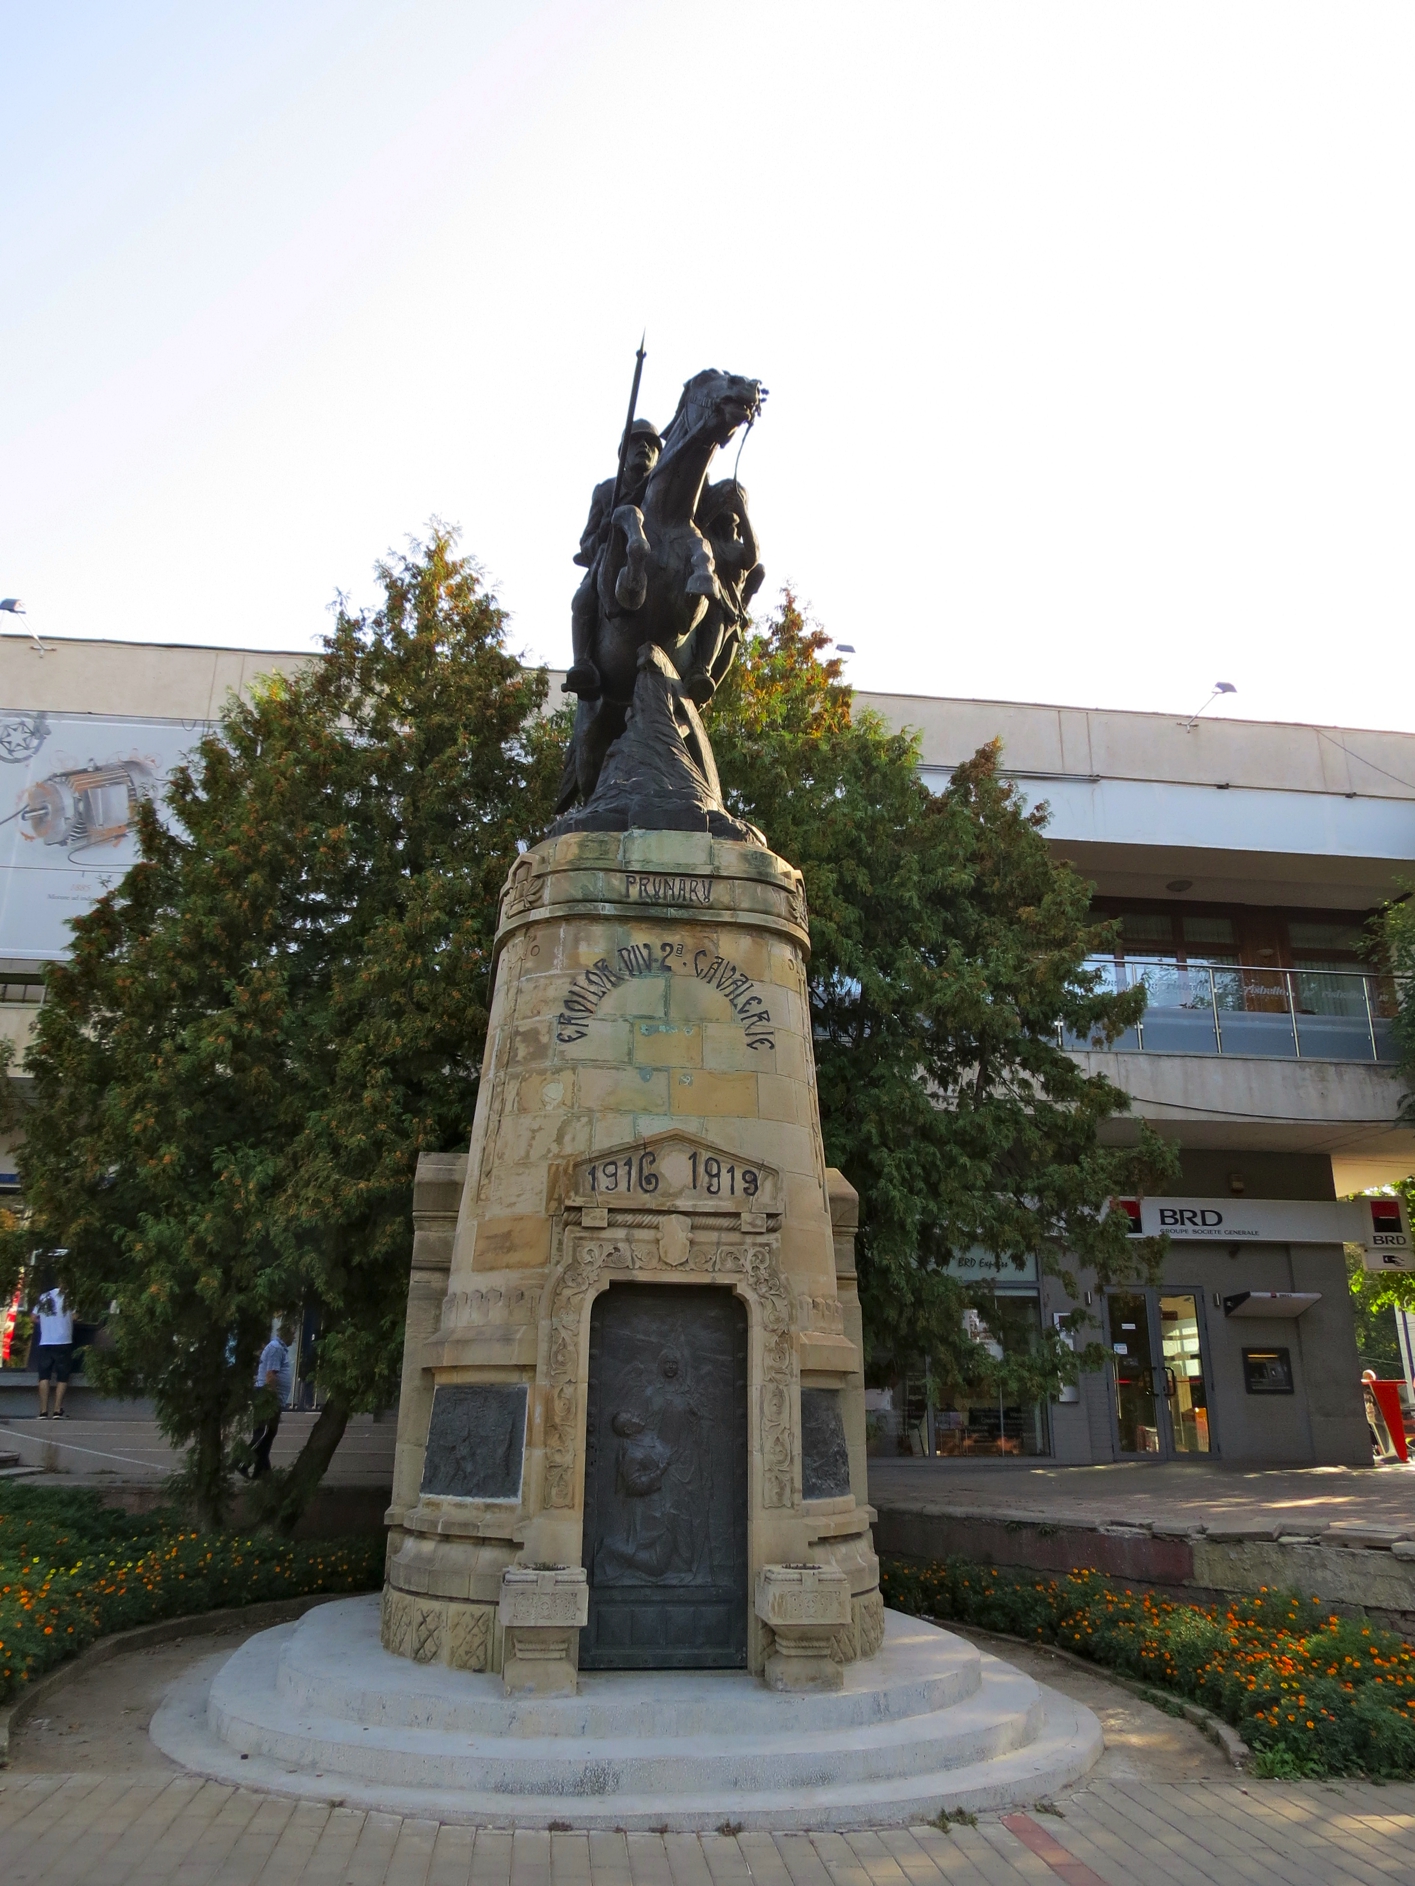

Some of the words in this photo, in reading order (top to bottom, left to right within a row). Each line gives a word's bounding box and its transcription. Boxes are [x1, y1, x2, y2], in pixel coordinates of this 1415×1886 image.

[556, 958, 626, 1043] EROILOR
[694, 949, 776, 1051] CAVALERIE
[588, 1151, 659, 1194] 1916
[688, 1152, 759, 1196] 1919
[1158, 1208, 1223, 1227] BRD
[1192, 1228, 1221, 1236] SOCIETE
[1372, 1235, 1407, 1246] BRD
[958, 1257, 977, 1268] BRD
